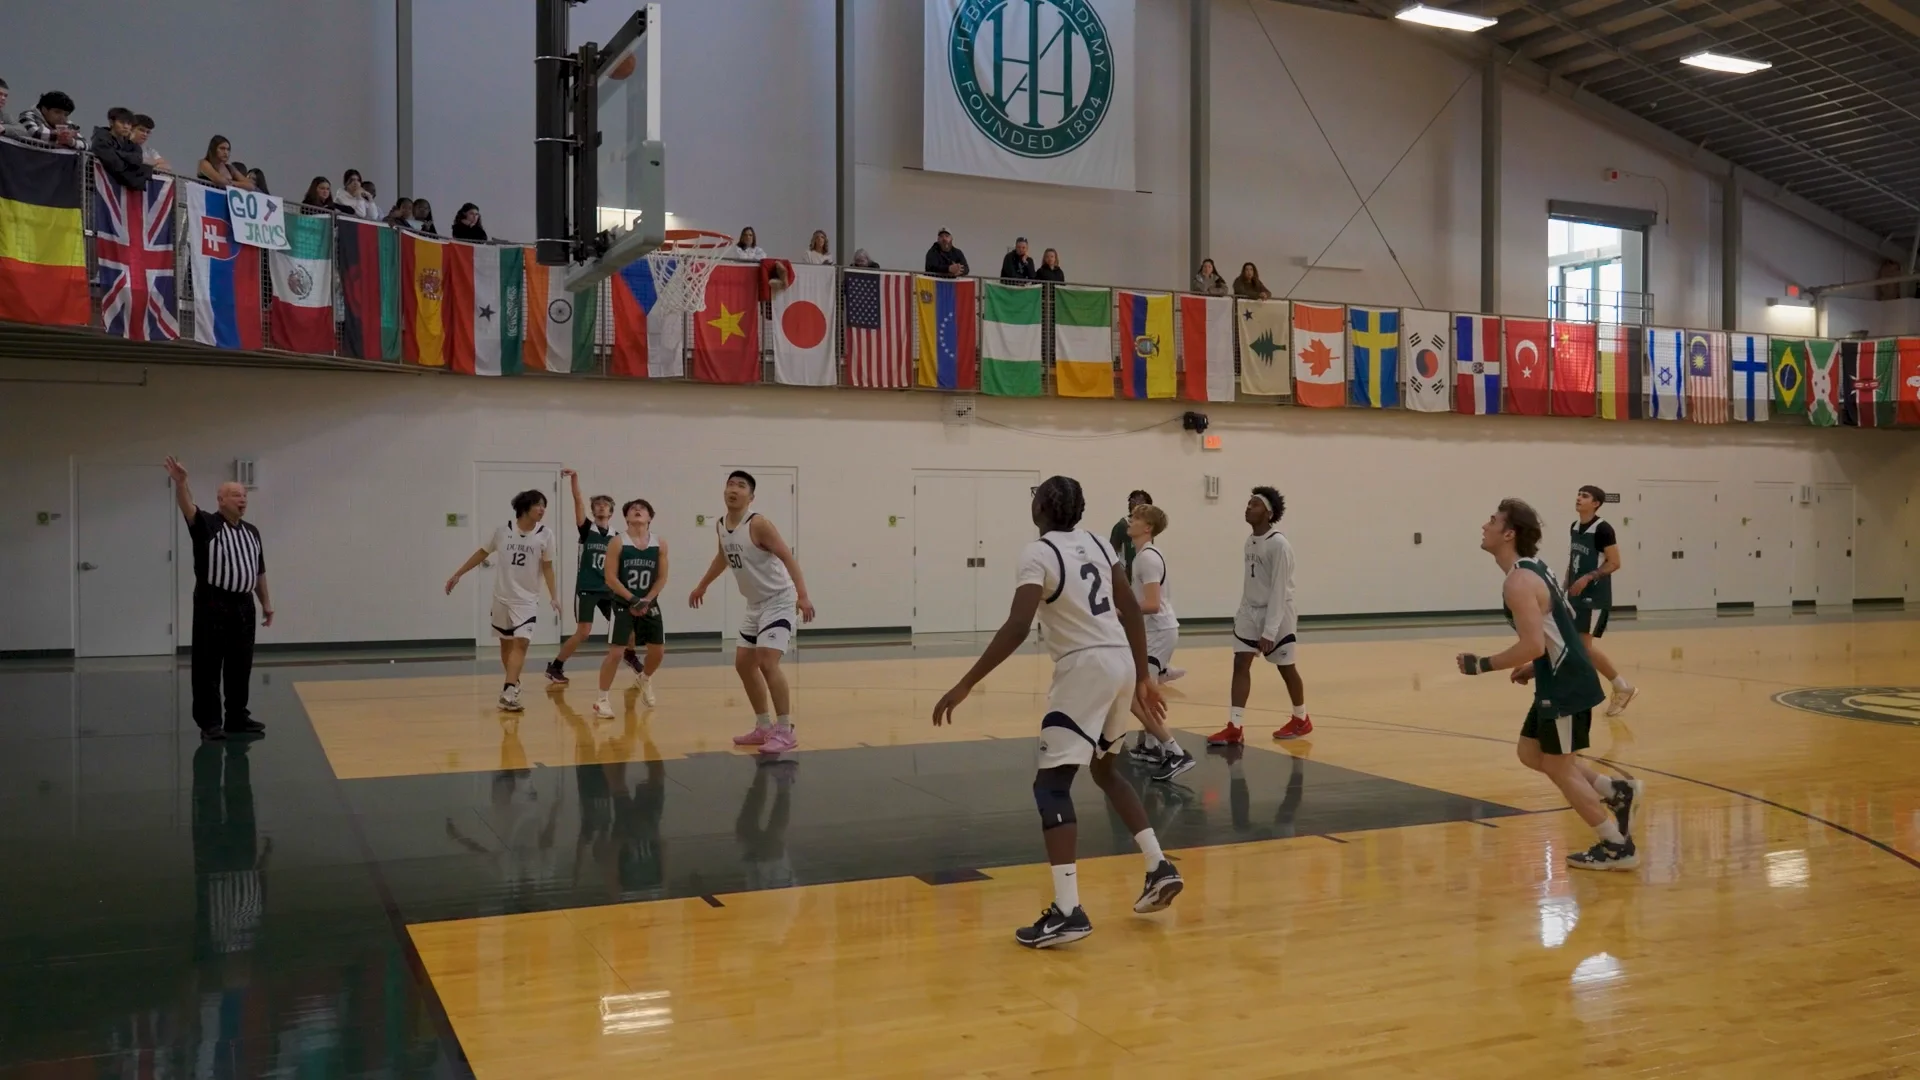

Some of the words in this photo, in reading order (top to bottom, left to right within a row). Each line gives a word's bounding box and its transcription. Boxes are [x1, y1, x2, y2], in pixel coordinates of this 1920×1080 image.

[961, 80, 1055, 150] FOUNDED
[1066, 96, 1102, 140] 1804
[228, 189, 258, 220] GO
[244, 222, 288, 248] JACKS
[506, 543, 535, 555] DUBLIN
[511, 552, 526, 567] 12
[591, 552, 606, 570] 10
[728, 553, 743, 569] 50
[627, 569, 652, 590] 20
[1250, 563, 1256, 578] 1
[1080, 562, 1111, 616] 2
